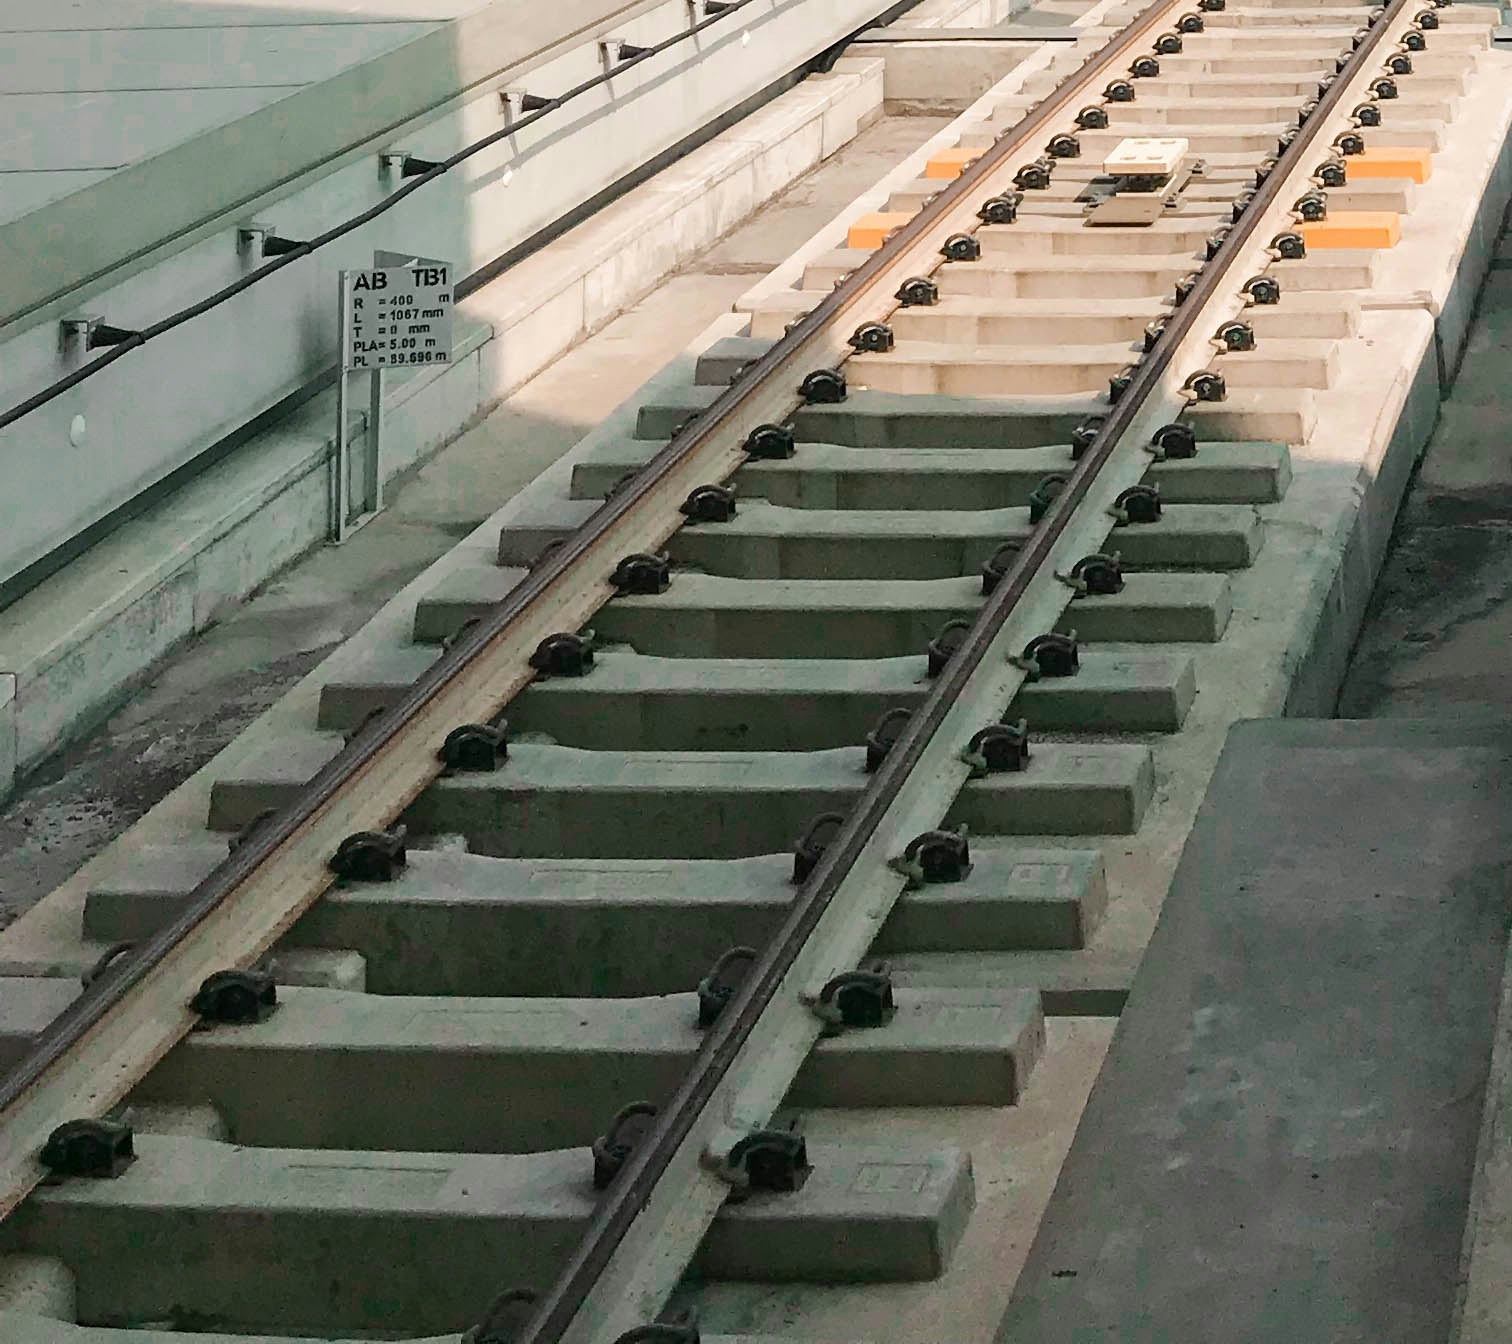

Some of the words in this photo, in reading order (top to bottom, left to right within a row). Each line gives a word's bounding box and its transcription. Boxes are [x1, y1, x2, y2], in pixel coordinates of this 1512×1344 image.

[353, 272, 388, 291] AB
[412, 267, 447, 287] TB1
[354, 297, 364, 310] R
[390, 295, 413, 306] 400
[438, 293, 450, 303] m
[354, 313, 362, 323] L
[390, 308, 420, 321] 1067
[422, 308, 444, 319] mm
[353, 327, 362, 338] T
[408, 323, 430, 335] mm
[390, 337, 416, 350] 5.00
[425, 338, 436, 347] m
[353, 356, 368, 368] PL
[435, 351, 447, 361] m
